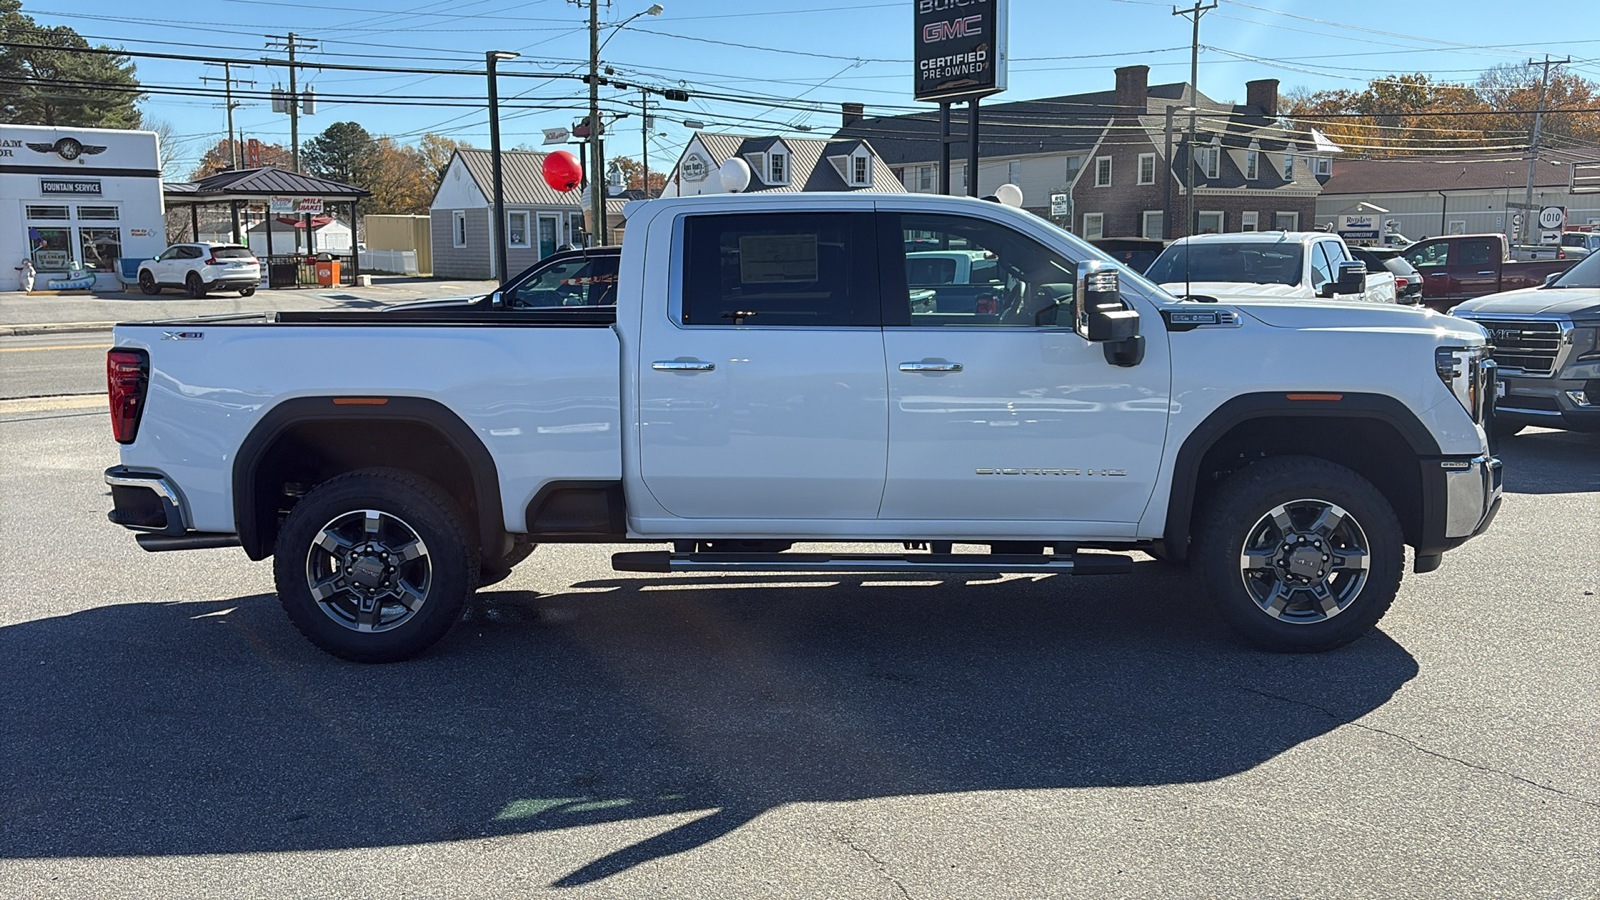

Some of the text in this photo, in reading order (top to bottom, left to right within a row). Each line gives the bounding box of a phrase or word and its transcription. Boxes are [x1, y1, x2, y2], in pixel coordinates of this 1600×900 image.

[920, 0, 987, 14] BUI
[923, 14, 982, 43] GMC
[920, 51, 986, 70] CERTIFIED
[923, 63, 982, 80] PRE-OWNED
[0, 139, 23, 149] AM
[43, 183, 100, 192] FOUNTAIN SERVICE
[1543, 213, 1561, 222] 1010
[1489, 329, 1521, 340] MC
[976, 468, 1081, 476] SIERRA
